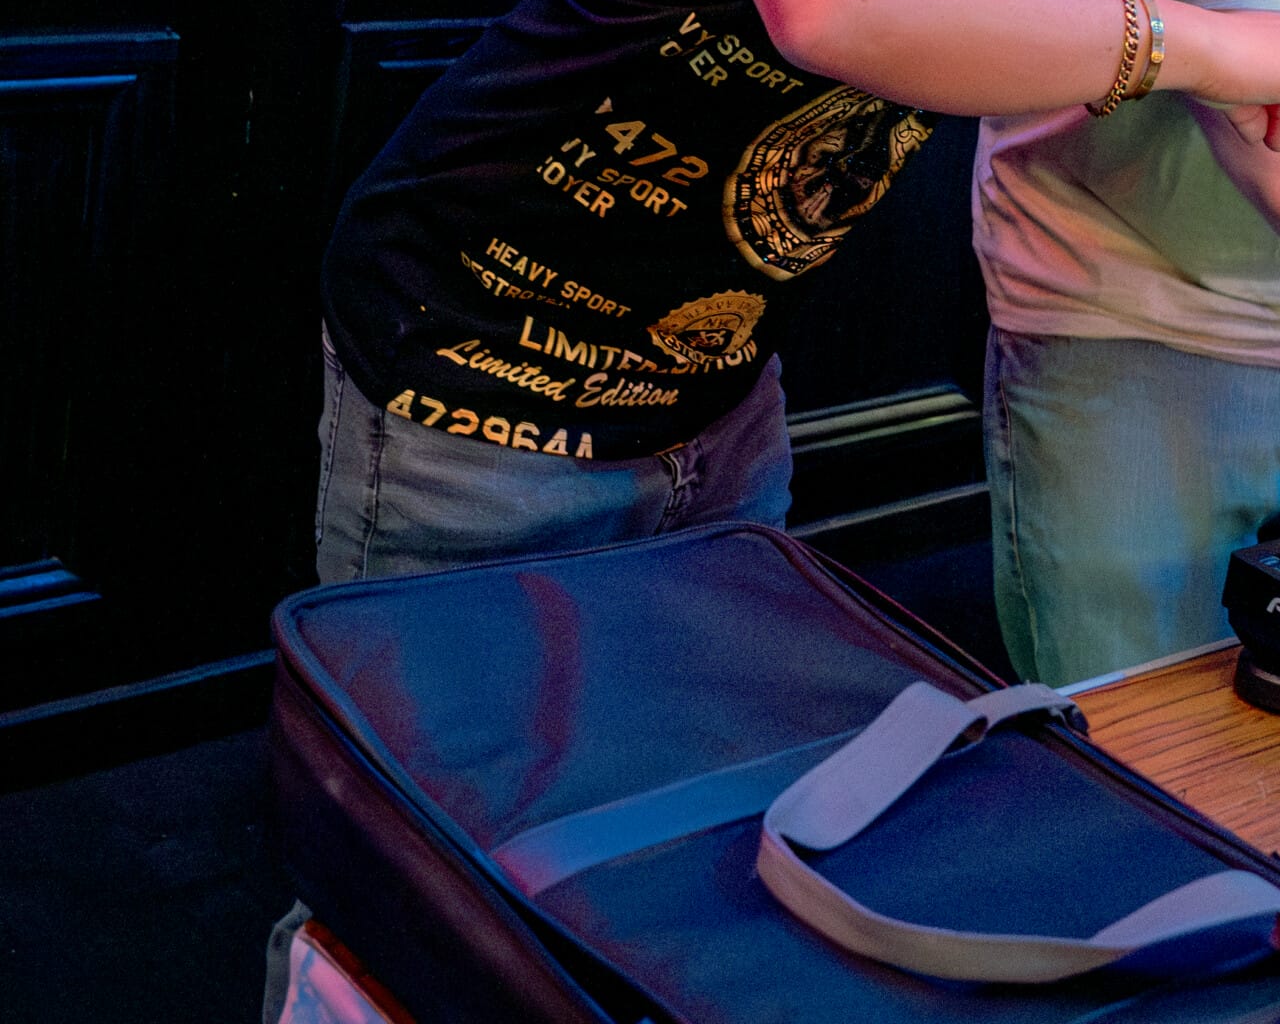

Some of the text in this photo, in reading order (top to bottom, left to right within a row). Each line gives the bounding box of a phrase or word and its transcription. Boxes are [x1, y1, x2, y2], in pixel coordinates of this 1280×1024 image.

[717, 34, 804, 94] SPORT
[536, 156, 616, 218] OYER
[597, 167, 688, 218] SPORT
[486, 237, 632, 318] HEAVY SPORT
[435, 339, 679, 409] Limited Edition
[385, 388, 594, 460] 472964A
